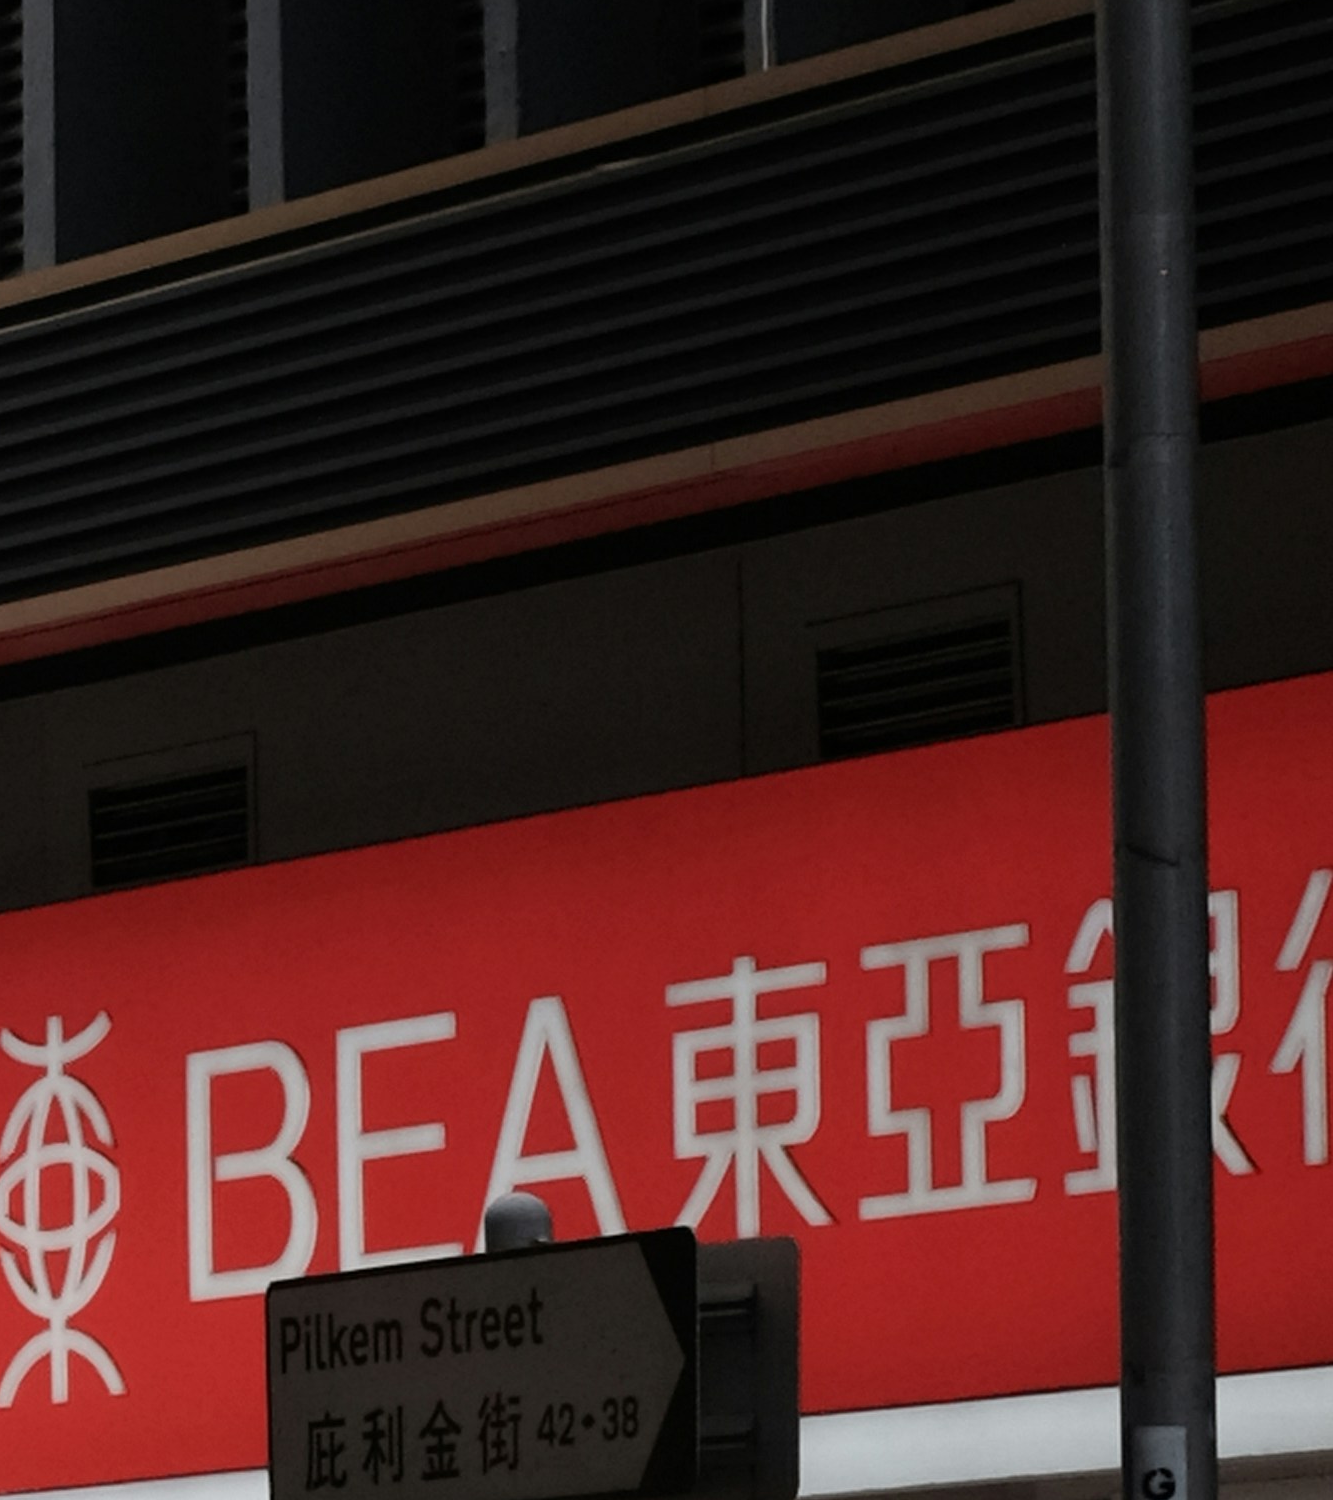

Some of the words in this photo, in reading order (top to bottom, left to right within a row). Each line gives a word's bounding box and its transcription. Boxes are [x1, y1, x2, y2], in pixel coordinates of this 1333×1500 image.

[184, 995, 628, 1303] BEA
[280, 1313, 403, 1374] Pilkem
[420, 1287, 543, 1358] Street
[305, 1391, 522, 1490] 庇利金街
